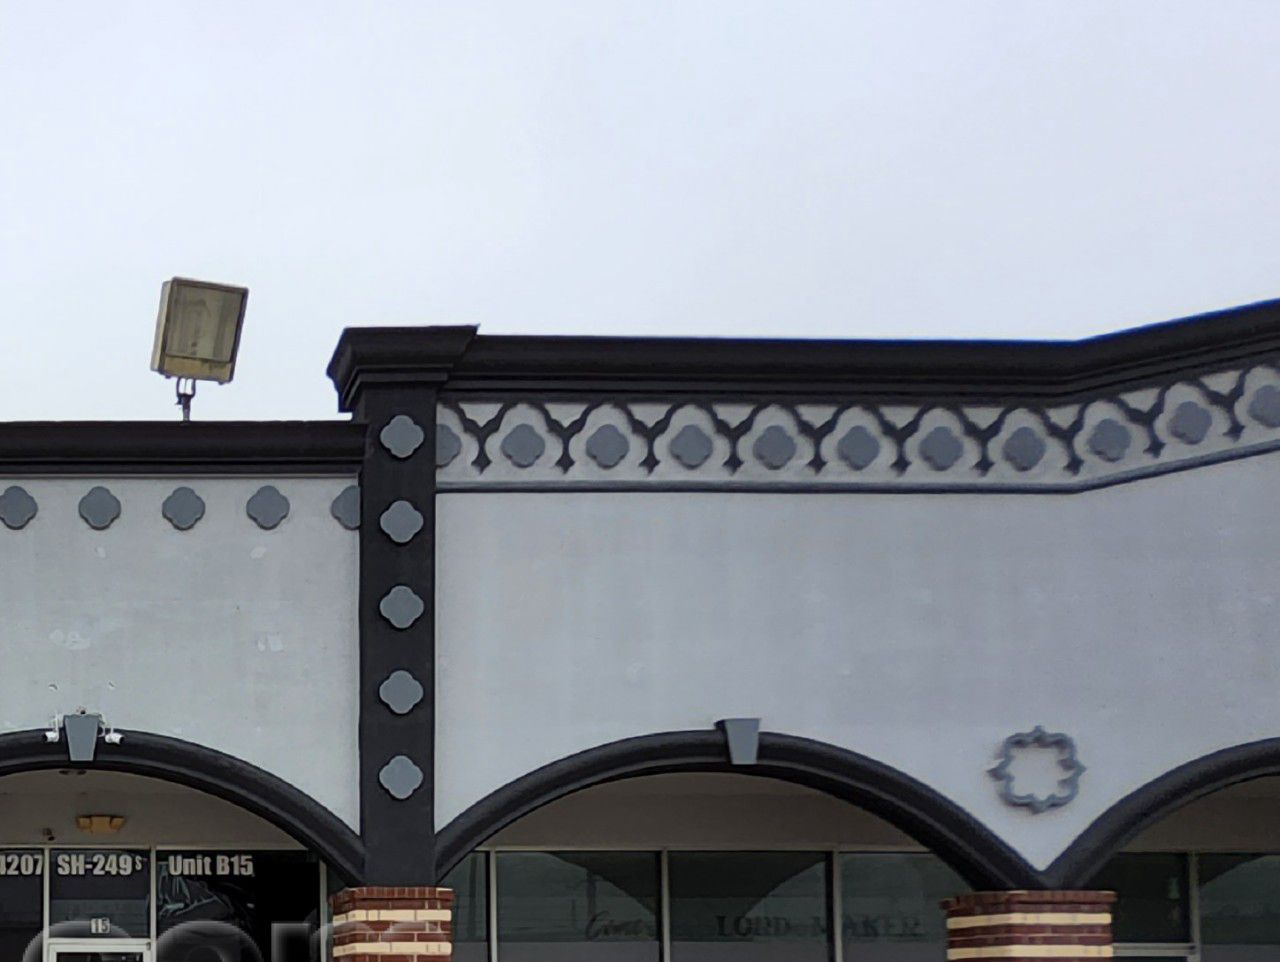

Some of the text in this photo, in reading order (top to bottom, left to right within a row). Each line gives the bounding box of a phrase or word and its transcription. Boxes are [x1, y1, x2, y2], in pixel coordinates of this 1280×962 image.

[57, 854, 133, 876] SH-249
[168, 854, 212, 876] Unit
[216, 854, 253, 876] B15
